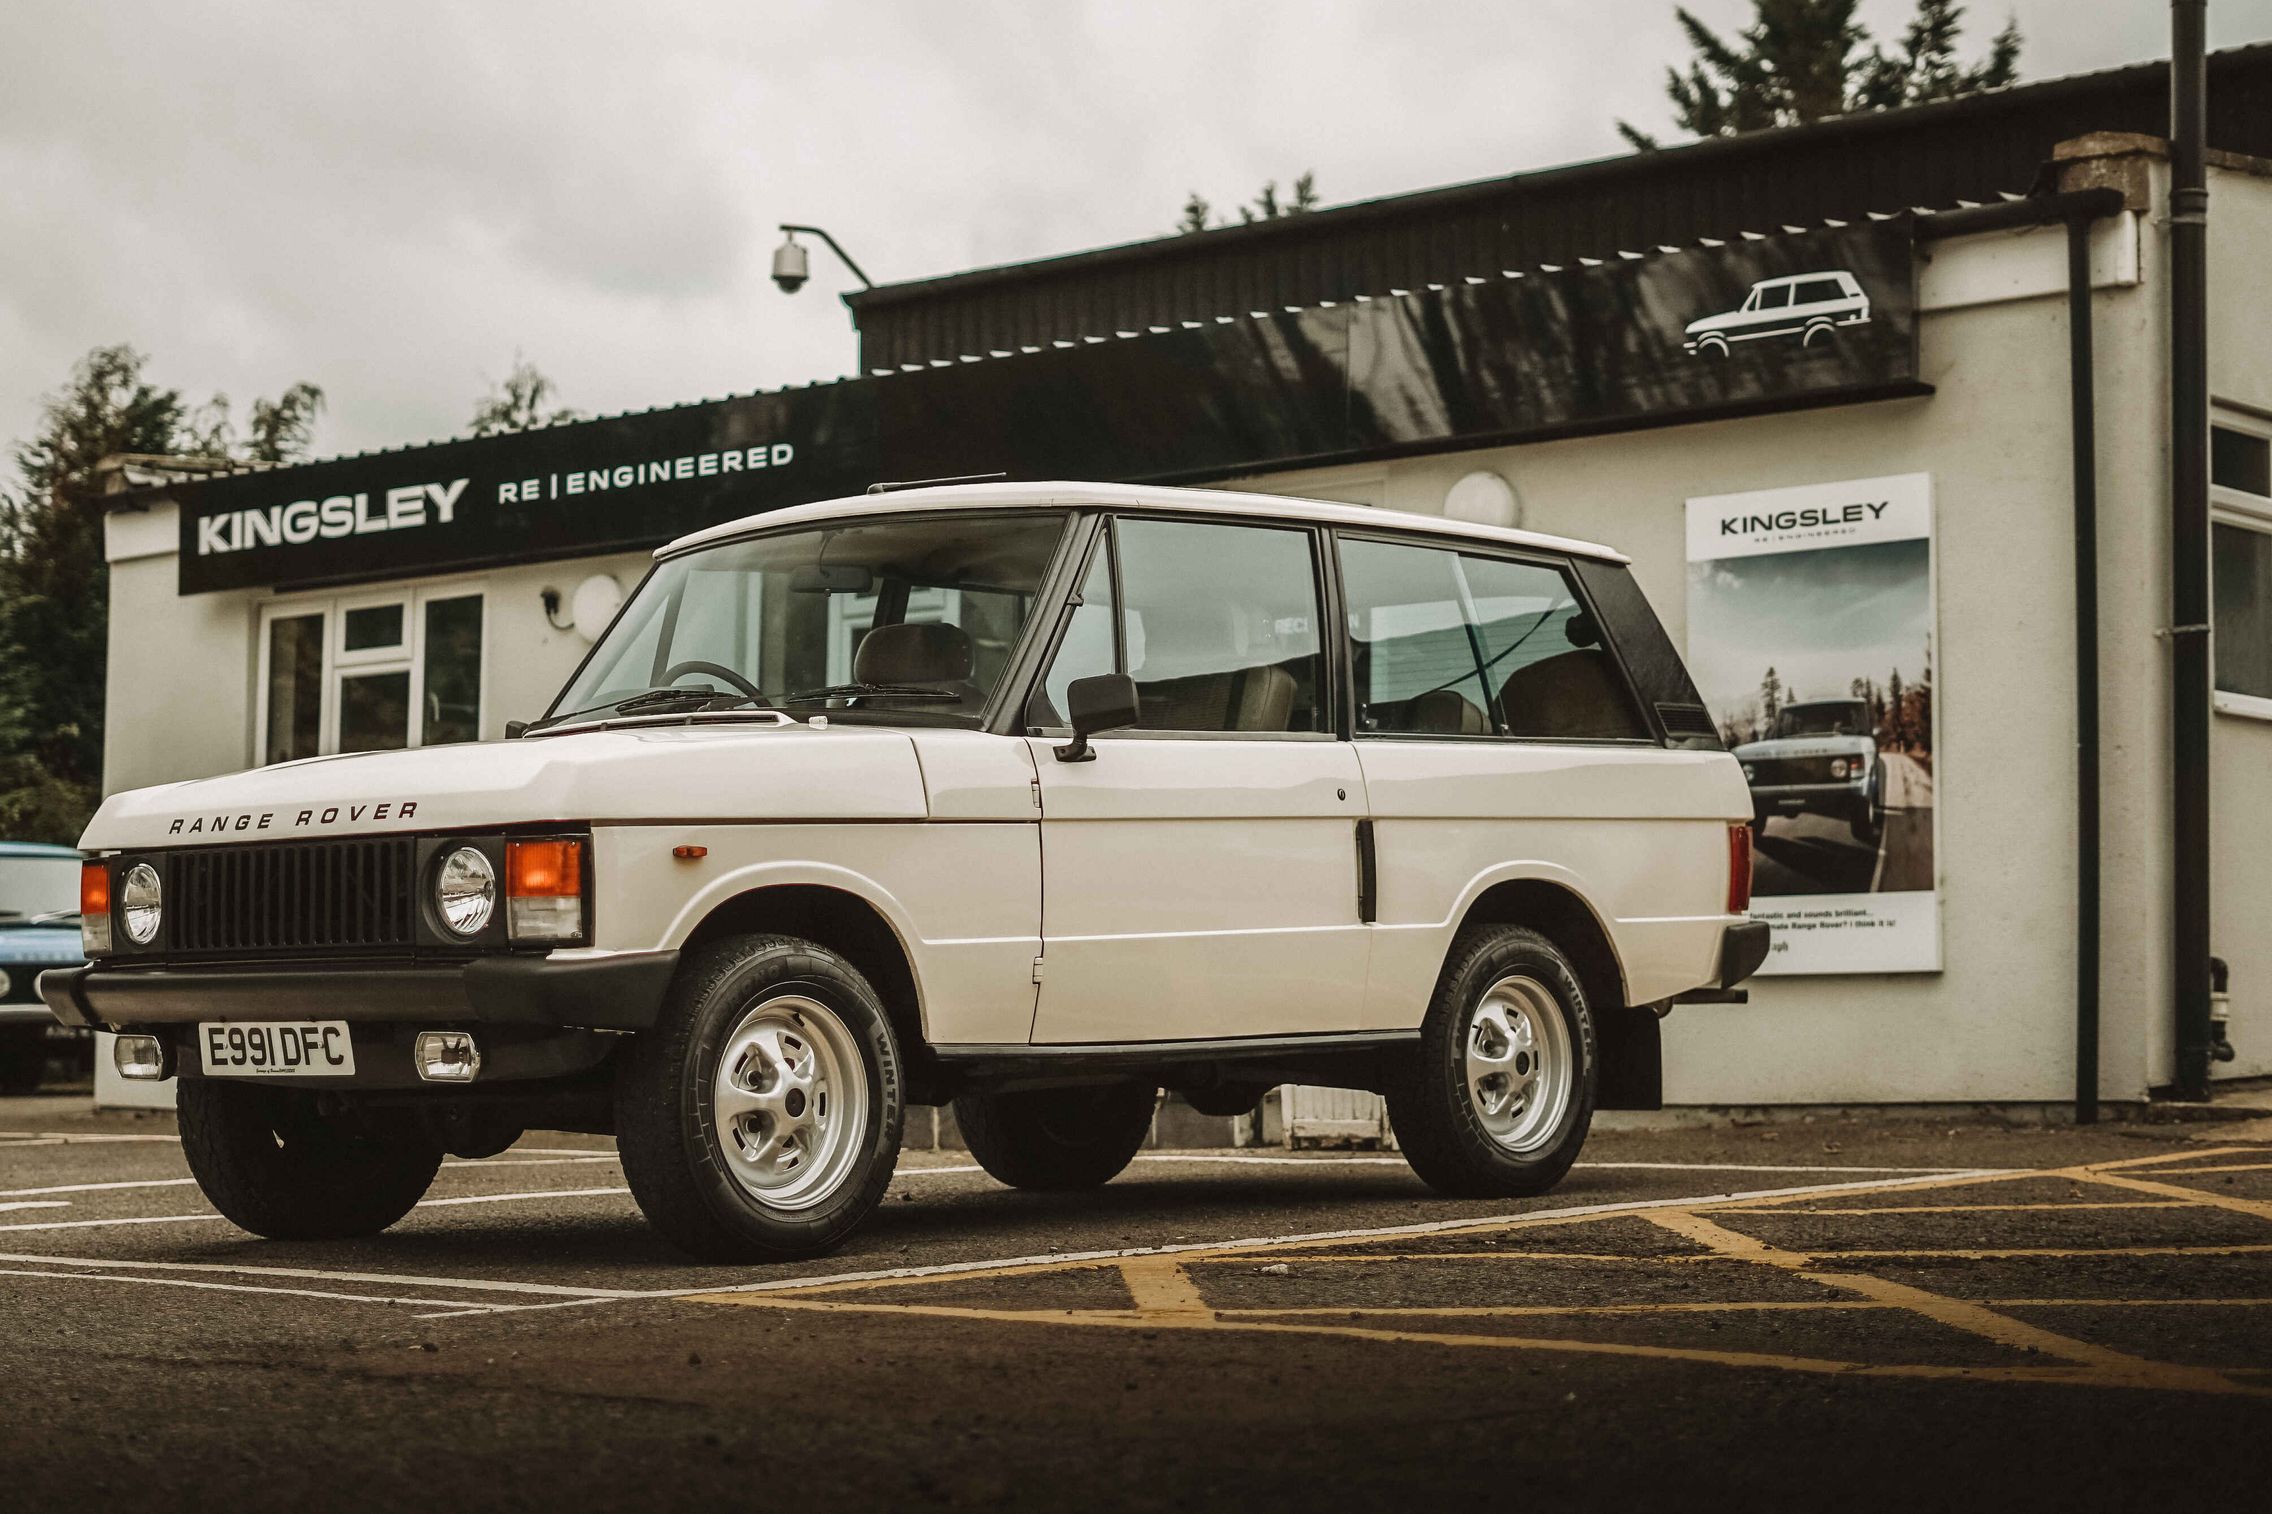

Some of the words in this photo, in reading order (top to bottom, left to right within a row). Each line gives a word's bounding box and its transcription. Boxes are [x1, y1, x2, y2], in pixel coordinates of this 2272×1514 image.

[198, 477, 470, 556] KINGSLEY
[1721, 501, 1888, 536] KINGSLEY
[168, 813, 274, 835] RANGE
[295, 802, 418, 826] ROVER
[1787, 911, 1801, 919] and
[1803, 910, 1833, 919] sounds
[1791, 922, 1817, 931] Range
[1564, 974, 1592, 1057] WINTER
[207, 1027, 276, 1066] E991
[279, 1026, 344, 1066] DFC
[876, 1031, 896, 1139] WINTER
